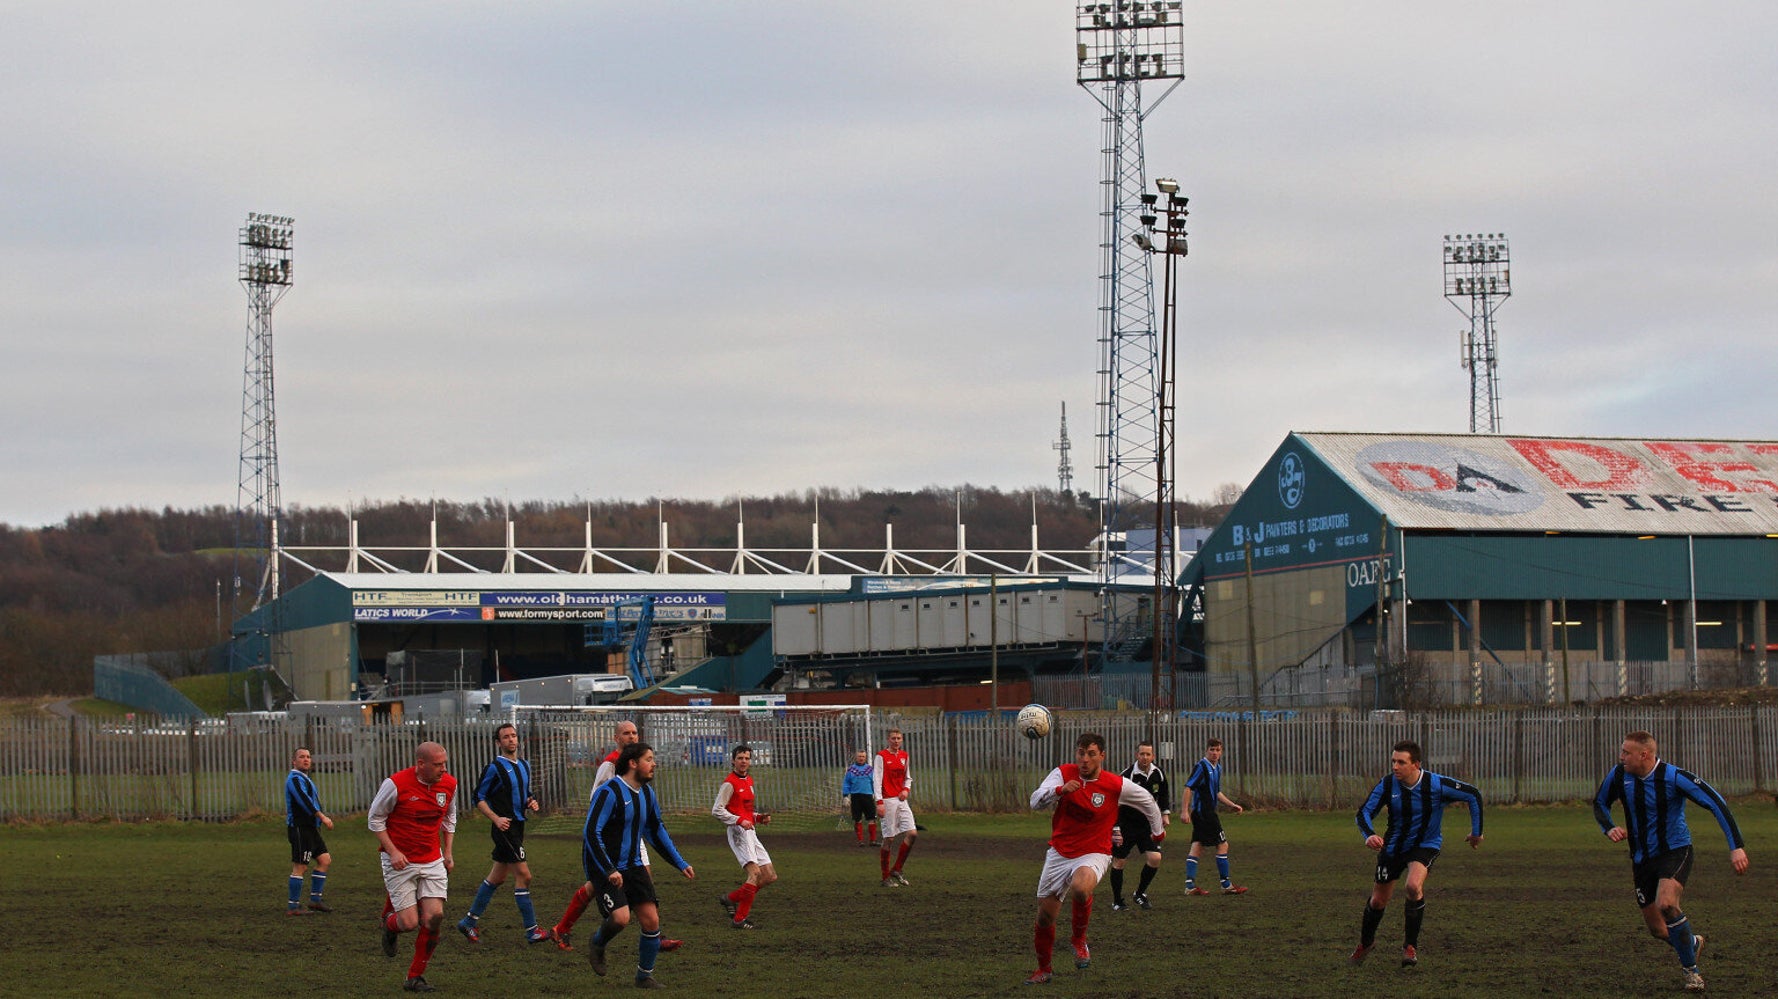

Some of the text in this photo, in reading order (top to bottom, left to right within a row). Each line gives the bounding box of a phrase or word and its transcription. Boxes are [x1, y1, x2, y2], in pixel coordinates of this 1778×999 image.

[1567, 492, 1754, 513] FIRE
[1233, 525, 1244, 546] B
[1254, 522, 1265, 543] J
[1265, 520, 1298, 538] PAINTERS
[1307, 513, 1349, 532] DECORATORS
[354, 592, 388, 600] HTF
[445, 592, 479, 600] HTF
[354, 608, 428, 617] LATICS WORLD
[498, 608, 603, 620] www.formysport.com
[519, 846, 526, 859] 6
[1377, 866, 1389, 880] 14
[603, 893, 614, 908] 3
